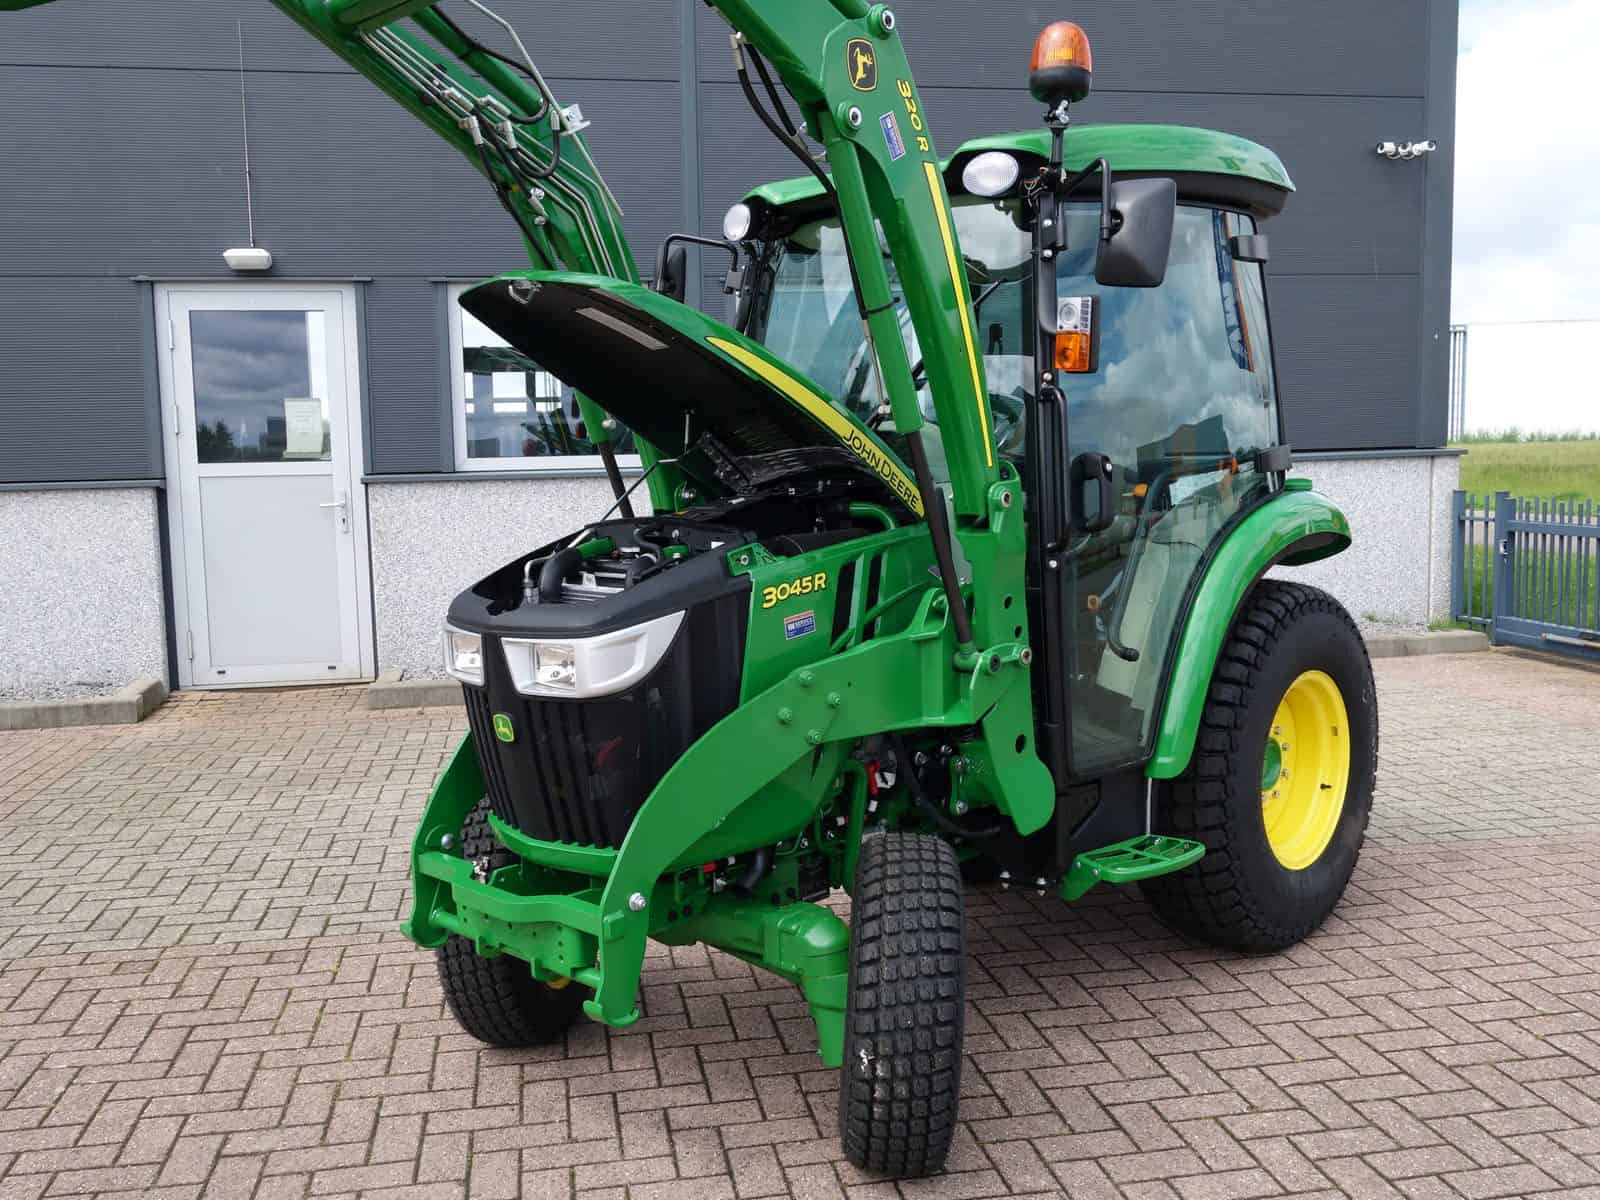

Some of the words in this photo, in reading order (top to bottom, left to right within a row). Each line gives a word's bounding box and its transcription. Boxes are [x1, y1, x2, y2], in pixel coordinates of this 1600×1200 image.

[896, 79, 922, 131] 320
[843, 429, 880, 469] JOHN
[880, 459, 919, 510] DEERE
